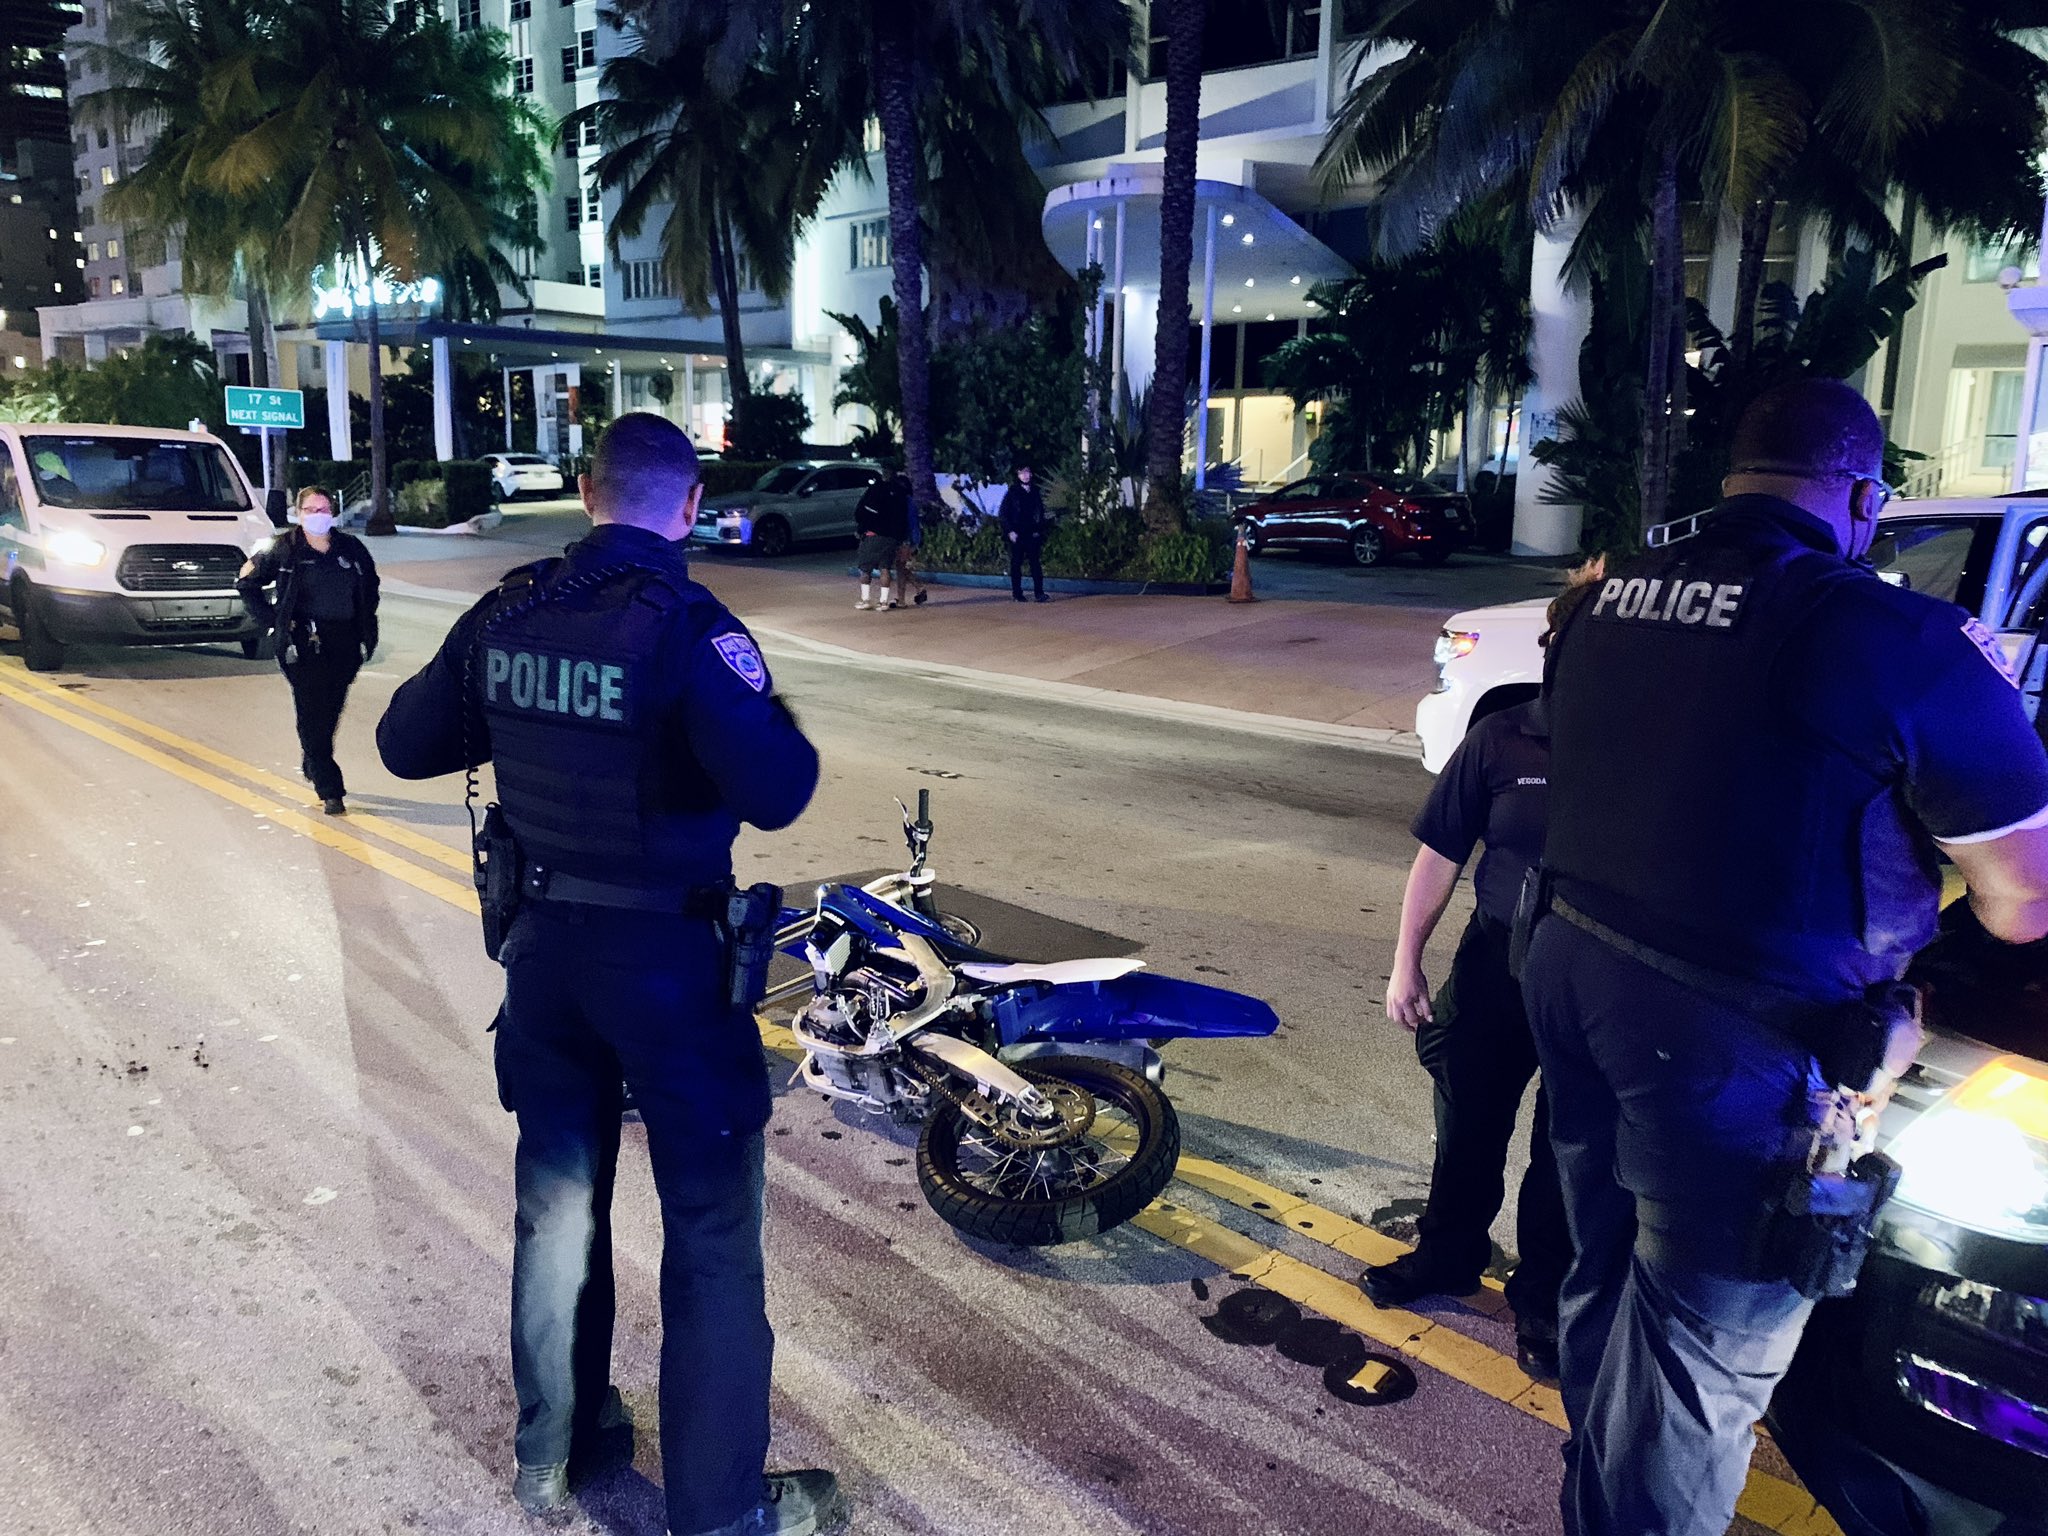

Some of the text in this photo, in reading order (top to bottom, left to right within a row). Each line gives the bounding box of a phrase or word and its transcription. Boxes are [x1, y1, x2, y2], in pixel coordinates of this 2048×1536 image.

[248, 393, 282, 406] 17 St
[231, 409, 299, 423] NEXT SIGNAL
[1592, 578, 1743, 627] POLICE
[487, 648, 624, 721] POLICE
